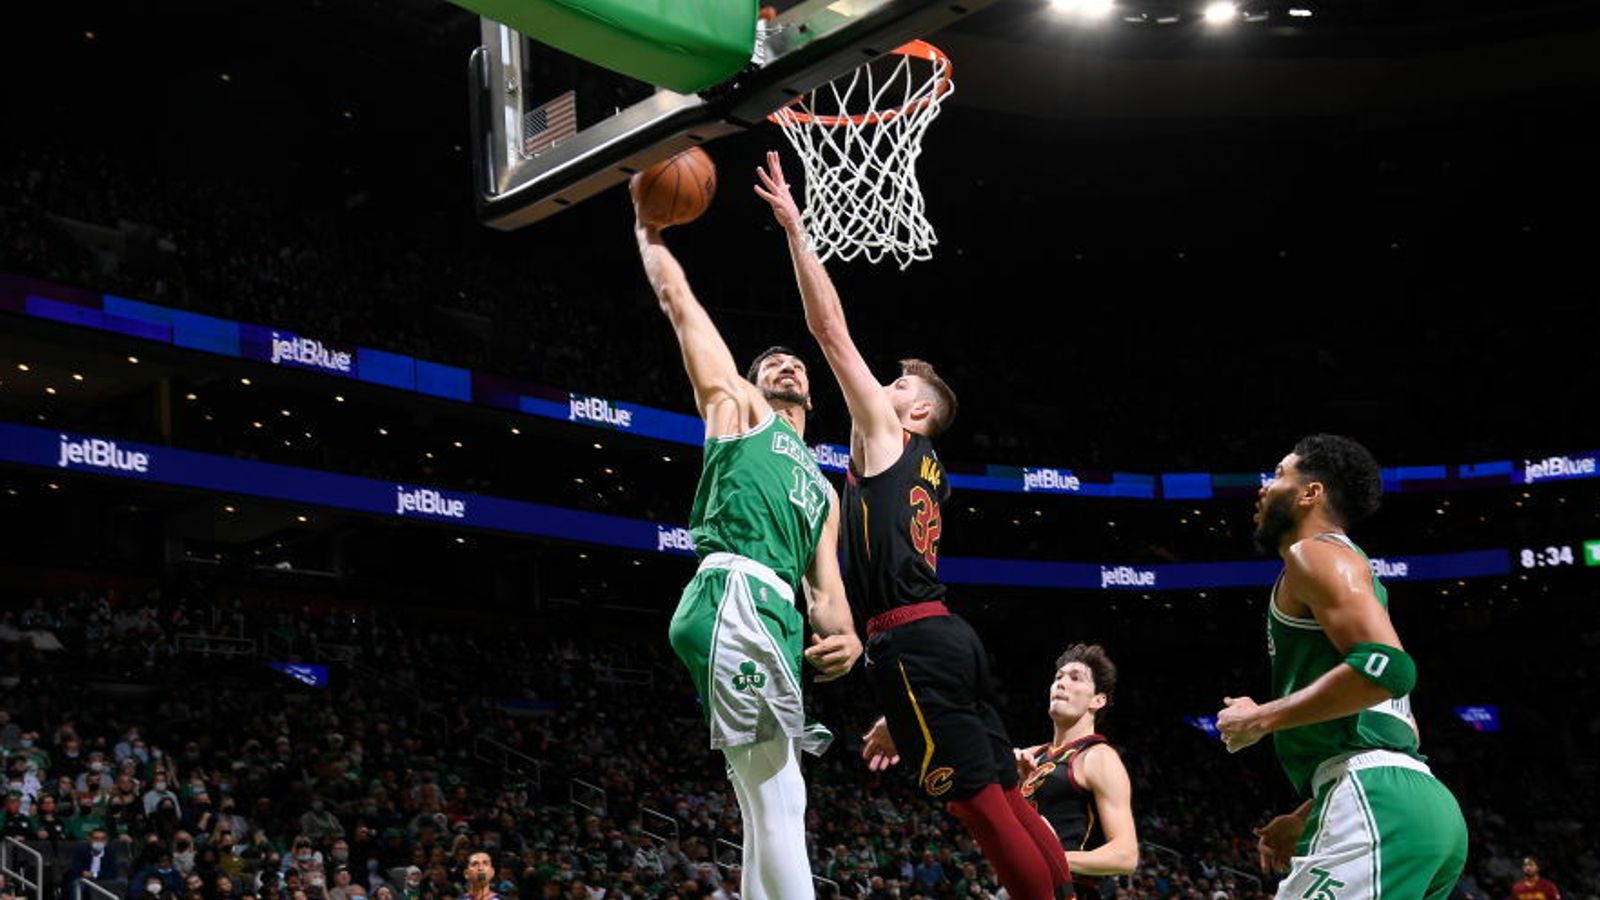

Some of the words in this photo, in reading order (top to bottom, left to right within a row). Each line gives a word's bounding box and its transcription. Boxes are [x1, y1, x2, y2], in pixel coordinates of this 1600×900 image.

[271, 332, 351, 372] jetBlue
[568, 393, 632, 427] jetBlue
[58, 434, 149, 473] jetBlue
[1023, 467, 1080, 492] jetBlue
[1525, 456, 1596, 484] jetBlue
[396, 485, 465, 518] jetBlue
[910, 486, 942, 572] 32
[1369, 558, 1409, 577] Blue
[1520, 545, 1575, 569] 8:34
[1101, 565, 1156, 589] jetBlue
[1364, 652, 1390, 678] 0
[1301, 866, 1347, 900] 75
